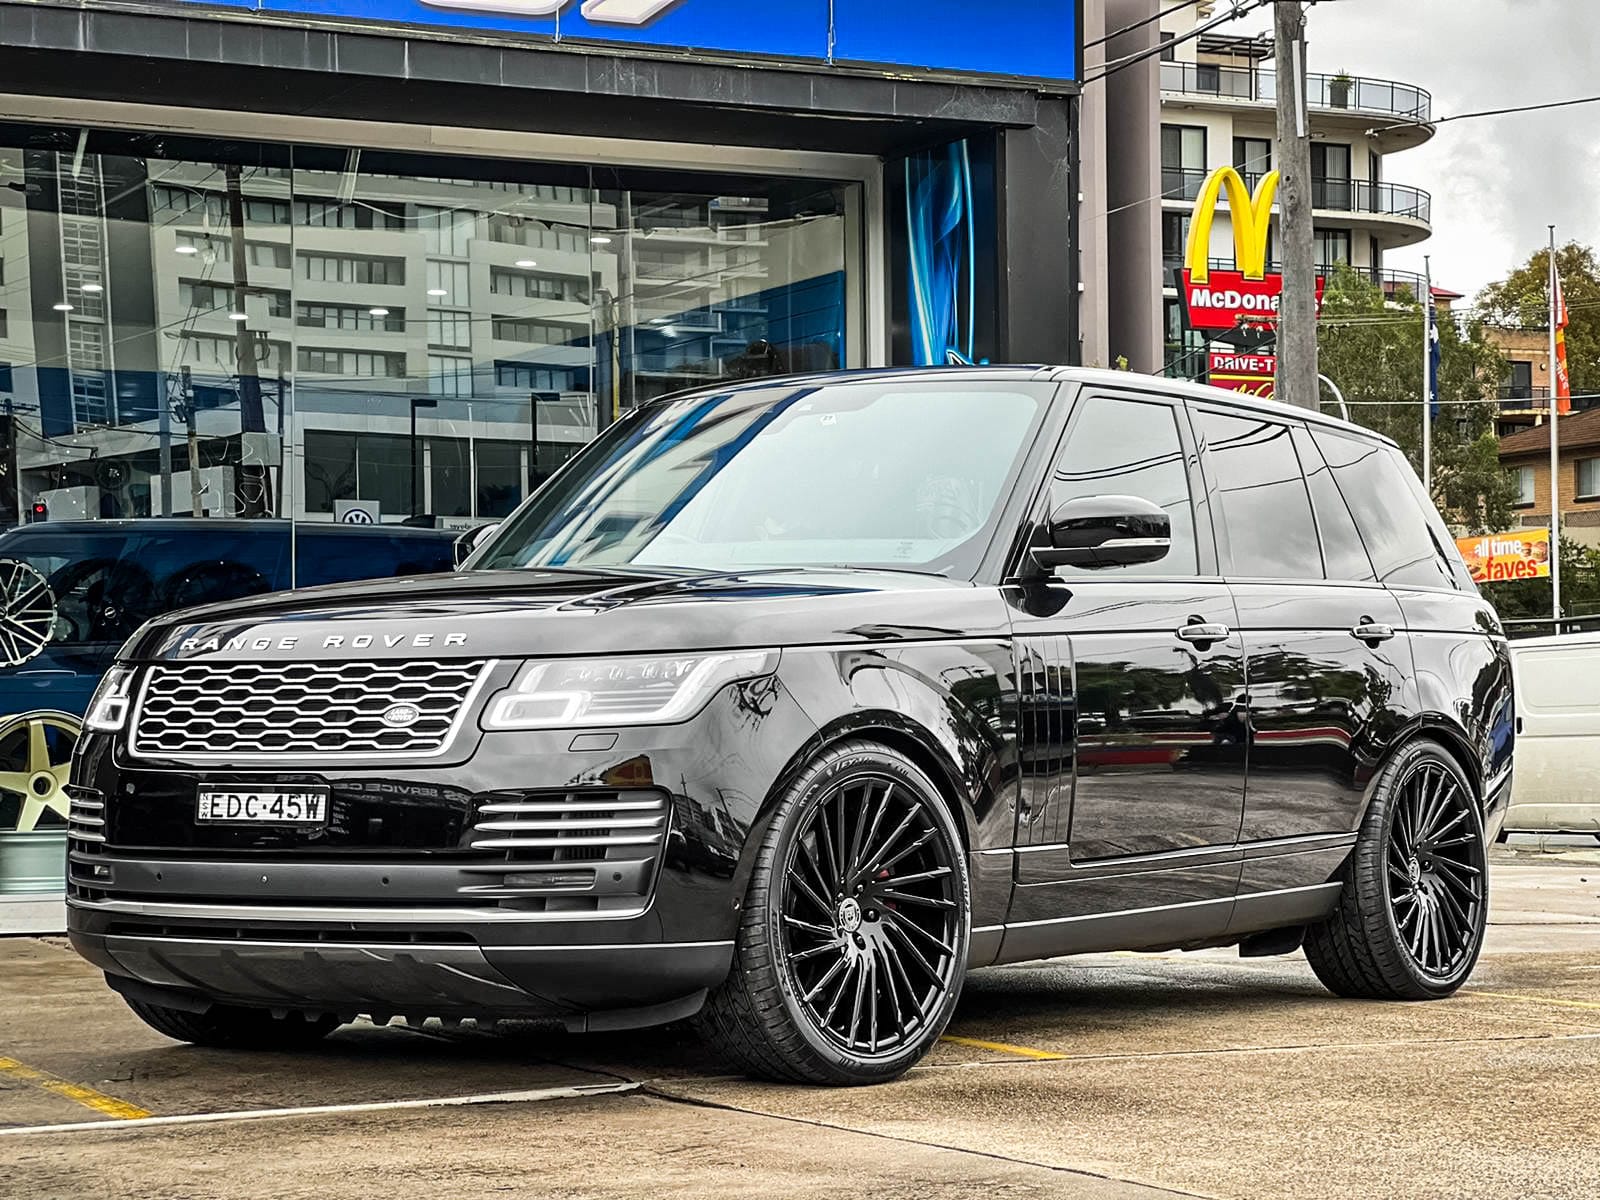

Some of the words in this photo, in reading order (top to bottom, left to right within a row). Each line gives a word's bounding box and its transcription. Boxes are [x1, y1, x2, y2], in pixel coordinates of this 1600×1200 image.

[1191, 288, 1319, 312] McDona
[1214, 356, 1275, 371] DRIVE-T
[1474, 538, 1489, 557] all
[1491, 538, 1522, 556] time
[1486, 557, 1537, 580] faves
[179, 635, 299, 651] RANGE
[322, 632, 468, 648] ROVER
